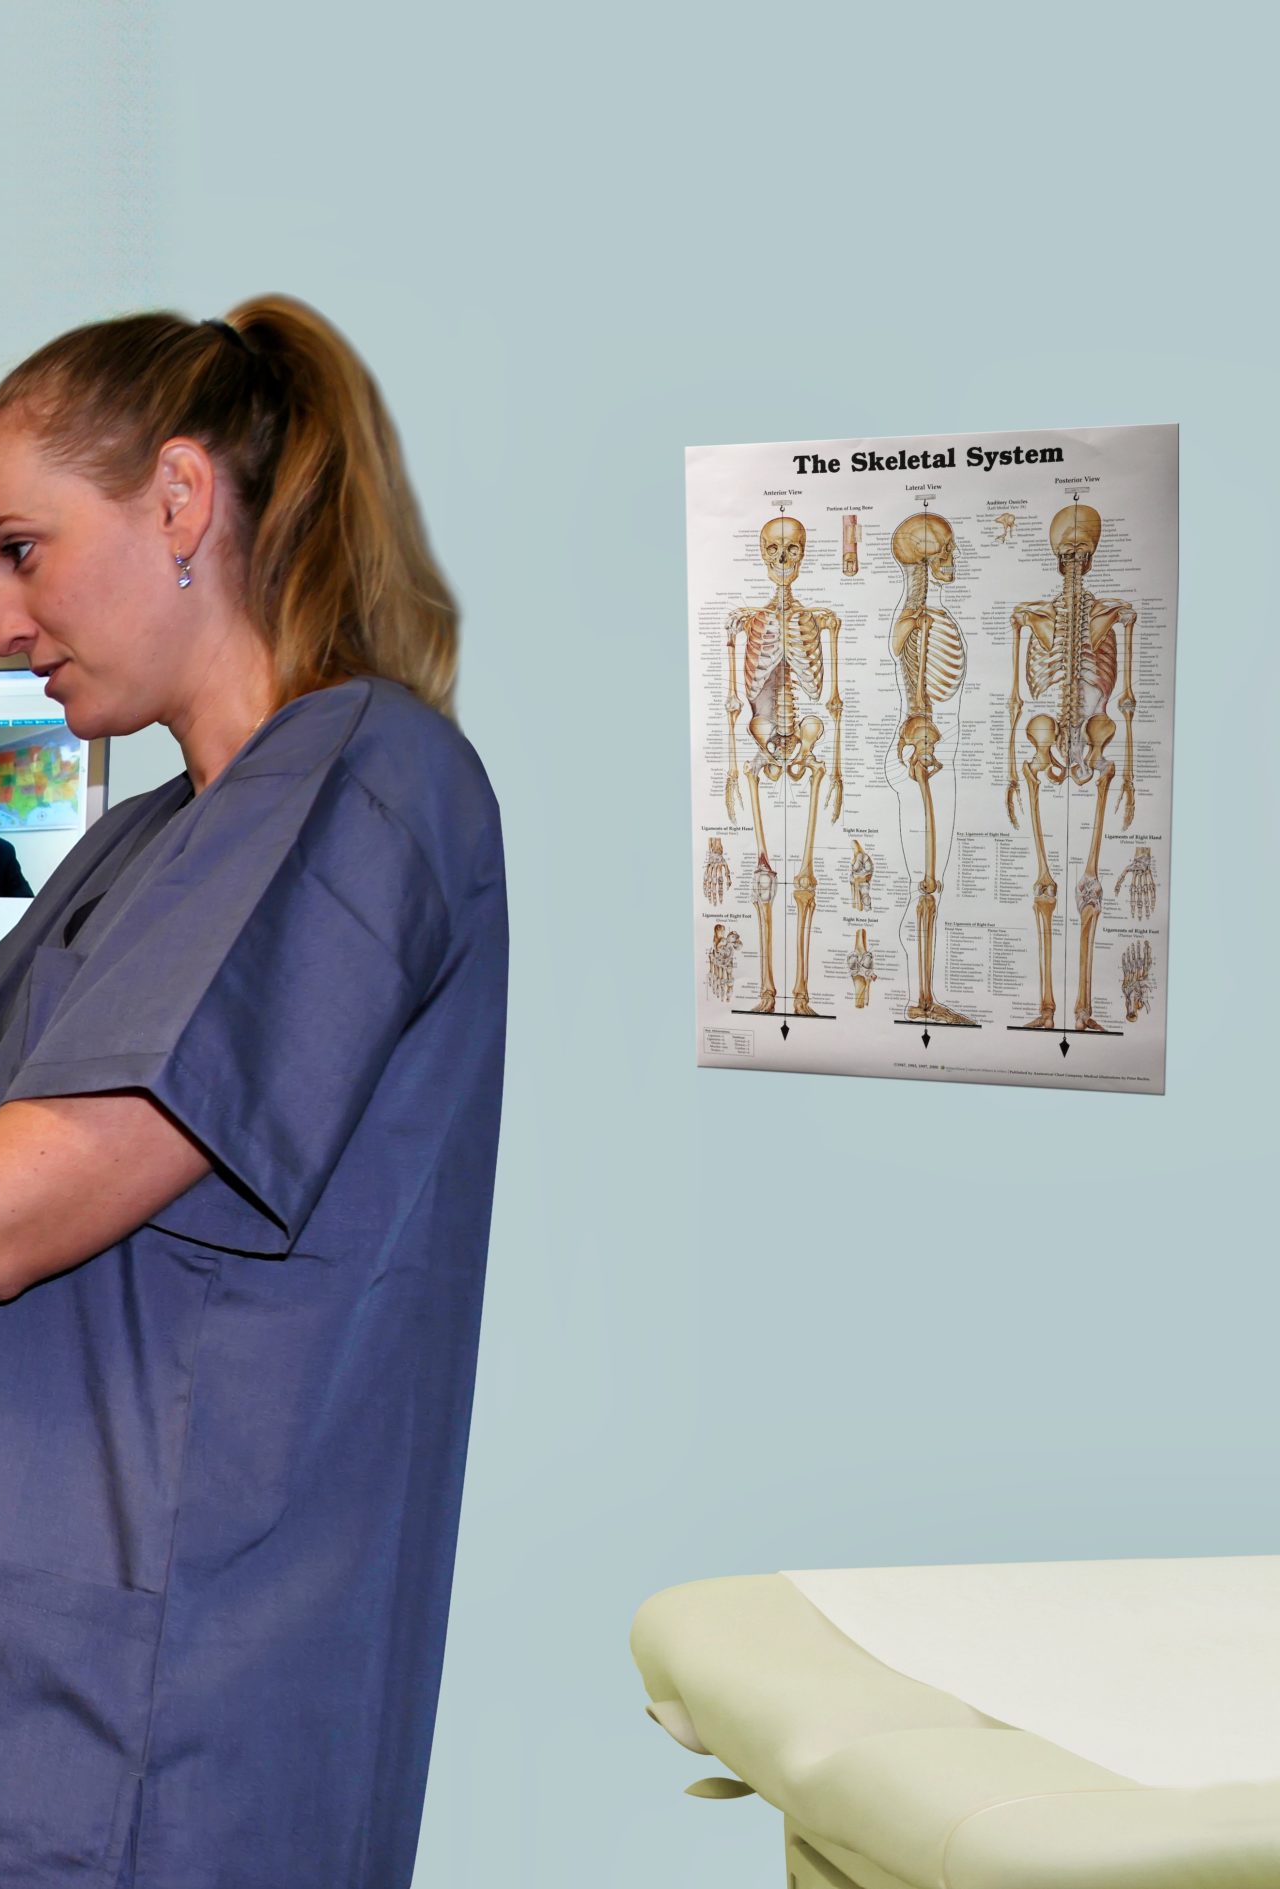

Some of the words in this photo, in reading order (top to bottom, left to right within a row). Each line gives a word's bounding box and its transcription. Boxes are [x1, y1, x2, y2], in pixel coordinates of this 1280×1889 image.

[793, 454, 840, 474] The
[851, 447, 956, 473] Skeletal
[966, 446, 1064, 472] System
